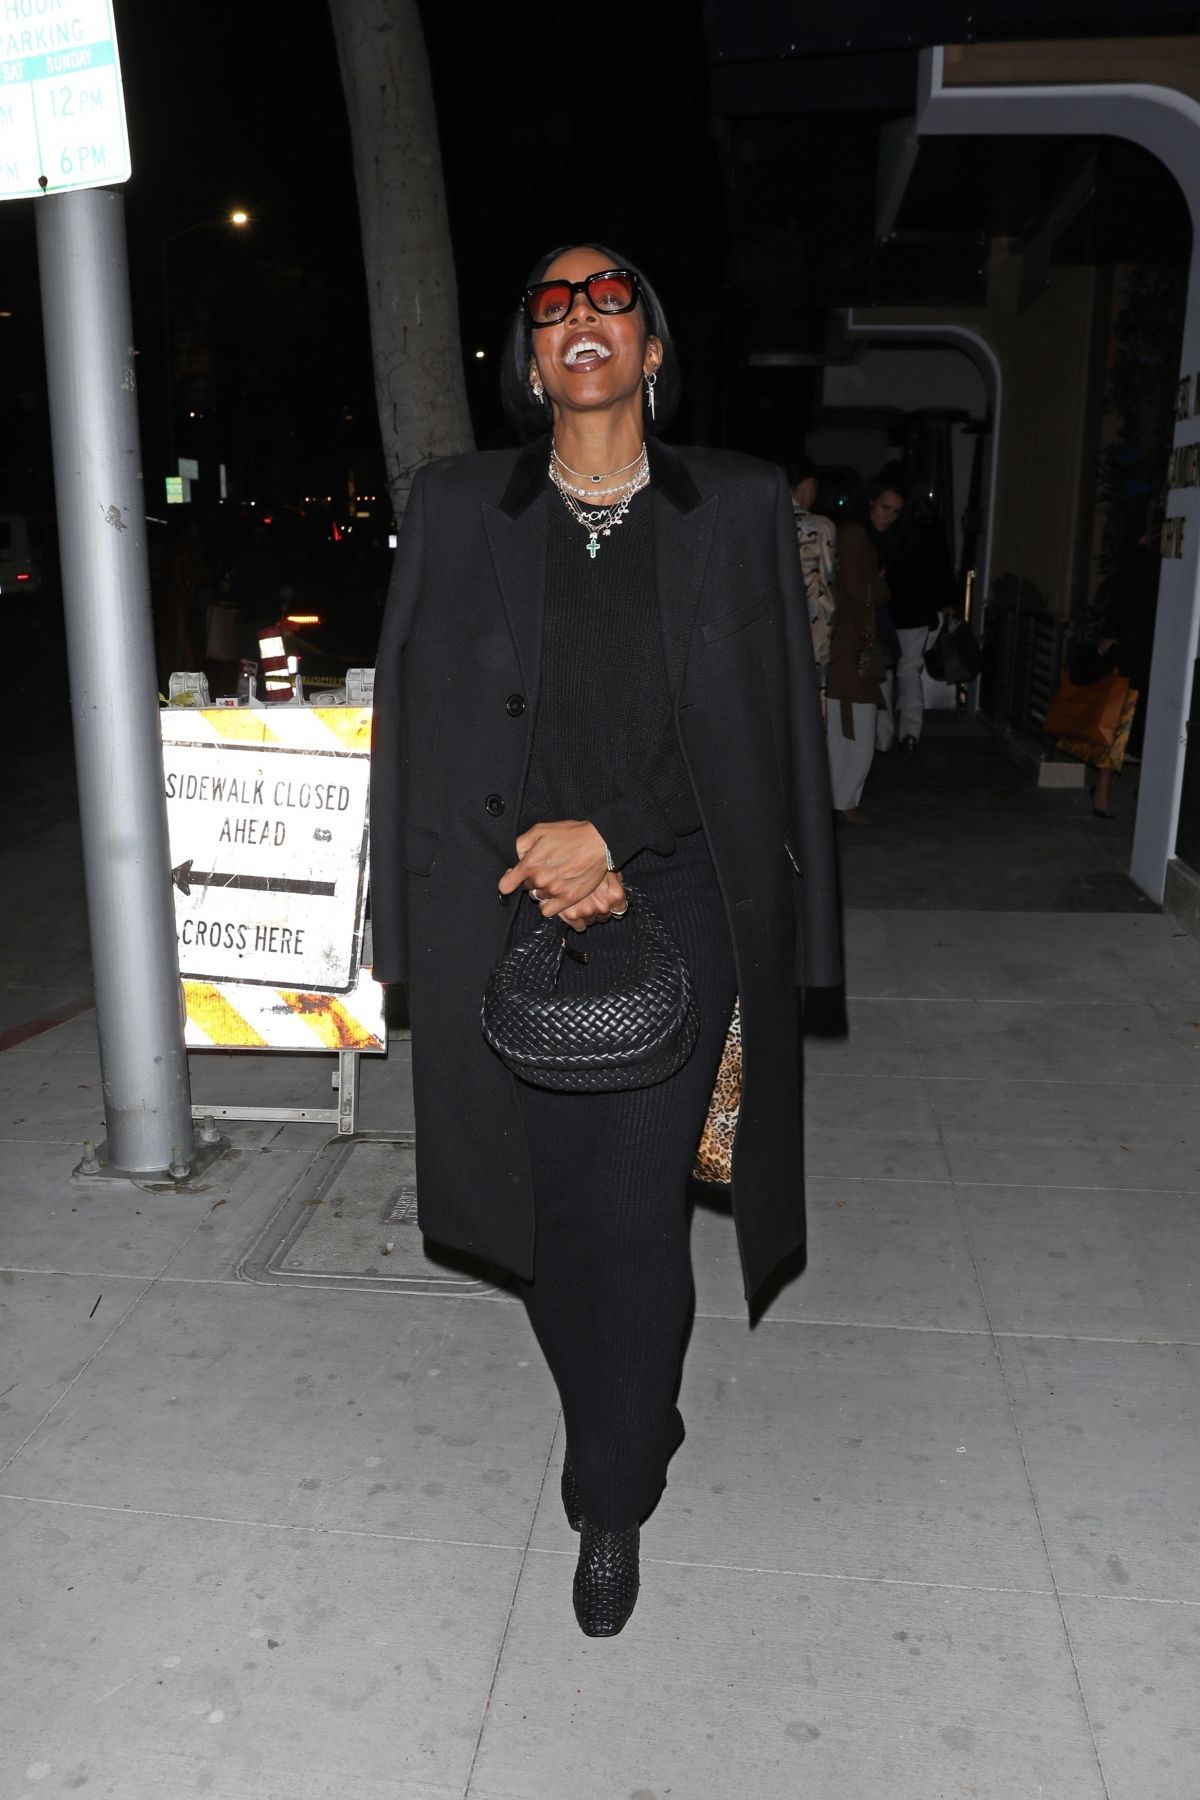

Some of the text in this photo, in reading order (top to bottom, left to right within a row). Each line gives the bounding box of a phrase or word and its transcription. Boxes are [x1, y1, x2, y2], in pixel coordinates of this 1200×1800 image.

[0, 18, 84, 56] ARKING
[2, 61, 23, 81] SAT
[47, 47, 92, 74] SUNDAY
[49, 86, 103, 118] 12 PM
[0, 161, 20, 183] M
[59, 143, 106, 175] 6 PM
[166, 773, 350, 811] SIDEWALK CLOSED
[219, 818, 286, 847] AHEAD
[182, 919, 305, 955] CROSS HERE
